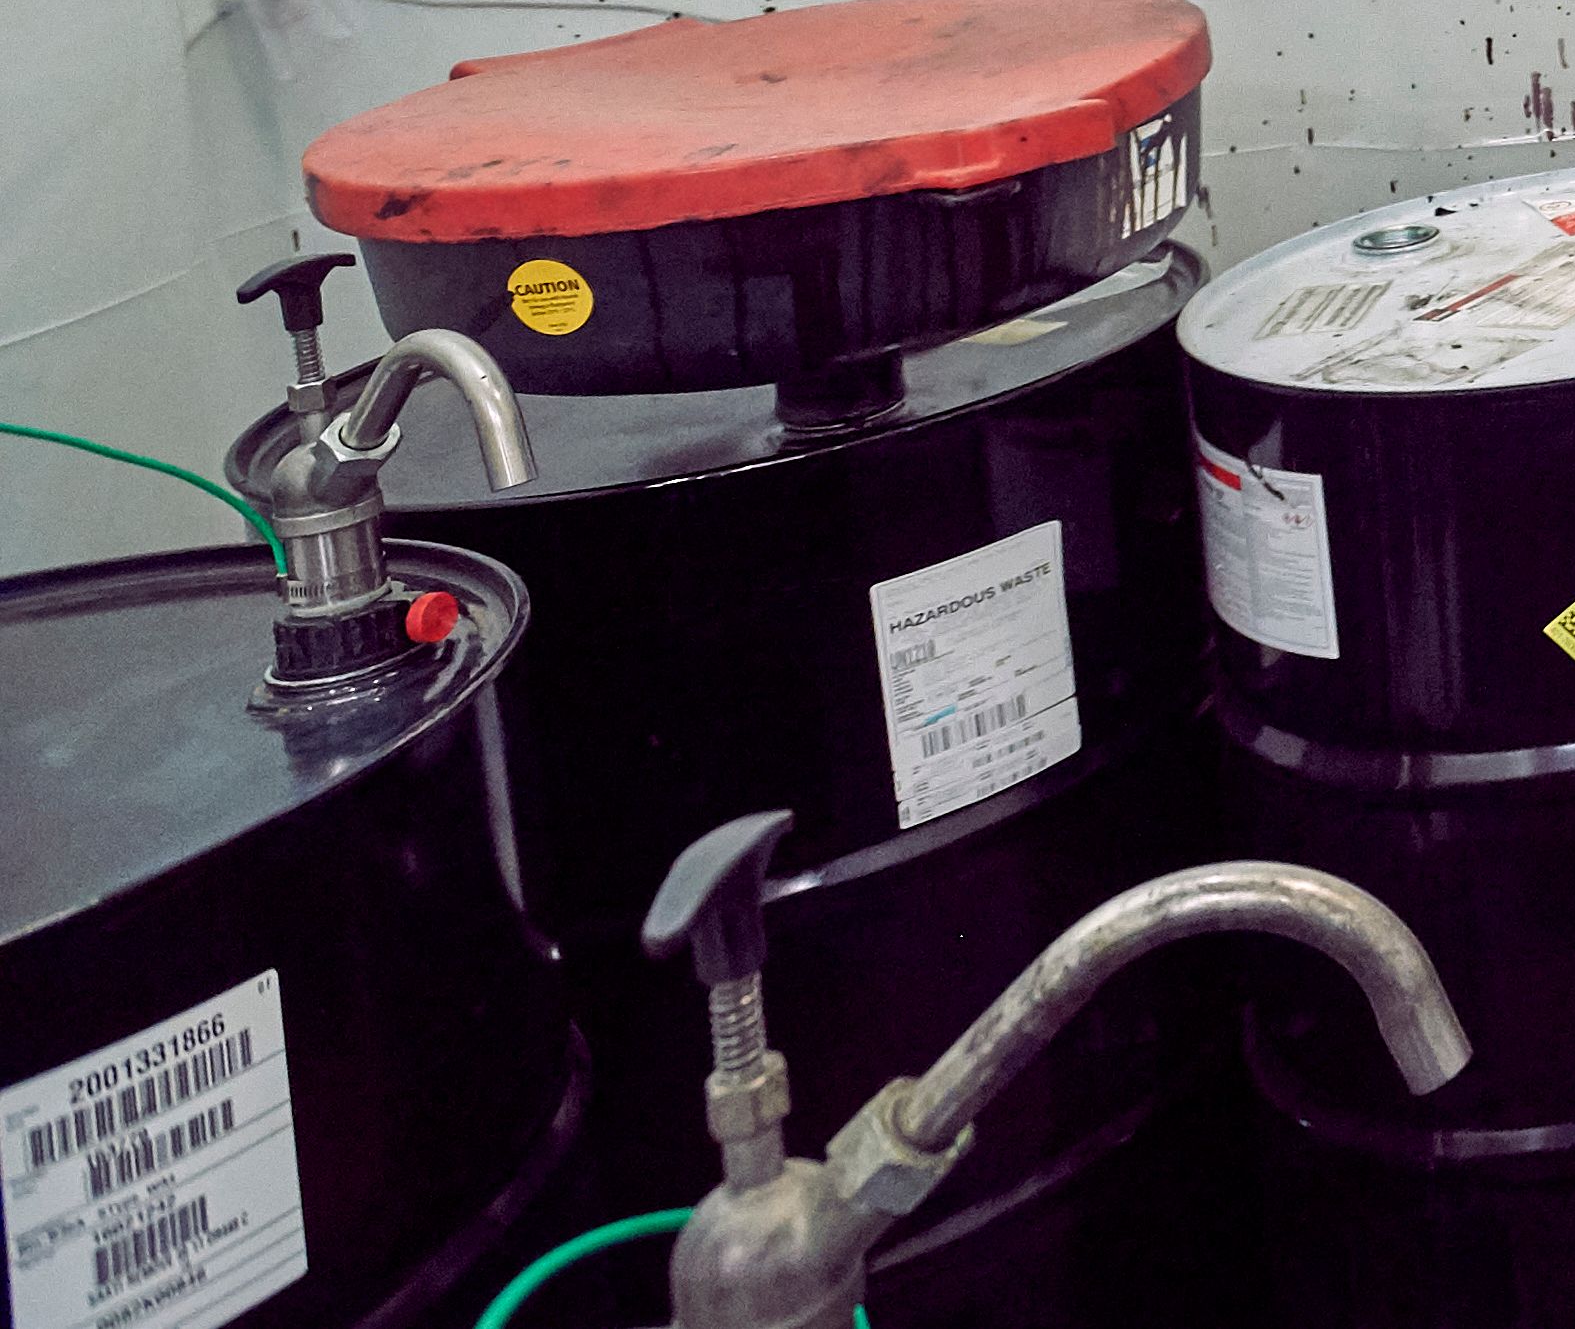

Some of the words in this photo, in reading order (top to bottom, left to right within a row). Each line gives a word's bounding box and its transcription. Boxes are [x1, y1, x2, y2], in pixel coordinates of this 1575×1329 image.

[515, 279, 580, 296] CAUTION
[890, 586, 996, 634] HAZARDOUS
[999, 561, 1052, 593] WASTE
[68, 1013, 226, 1104] 2001331866
